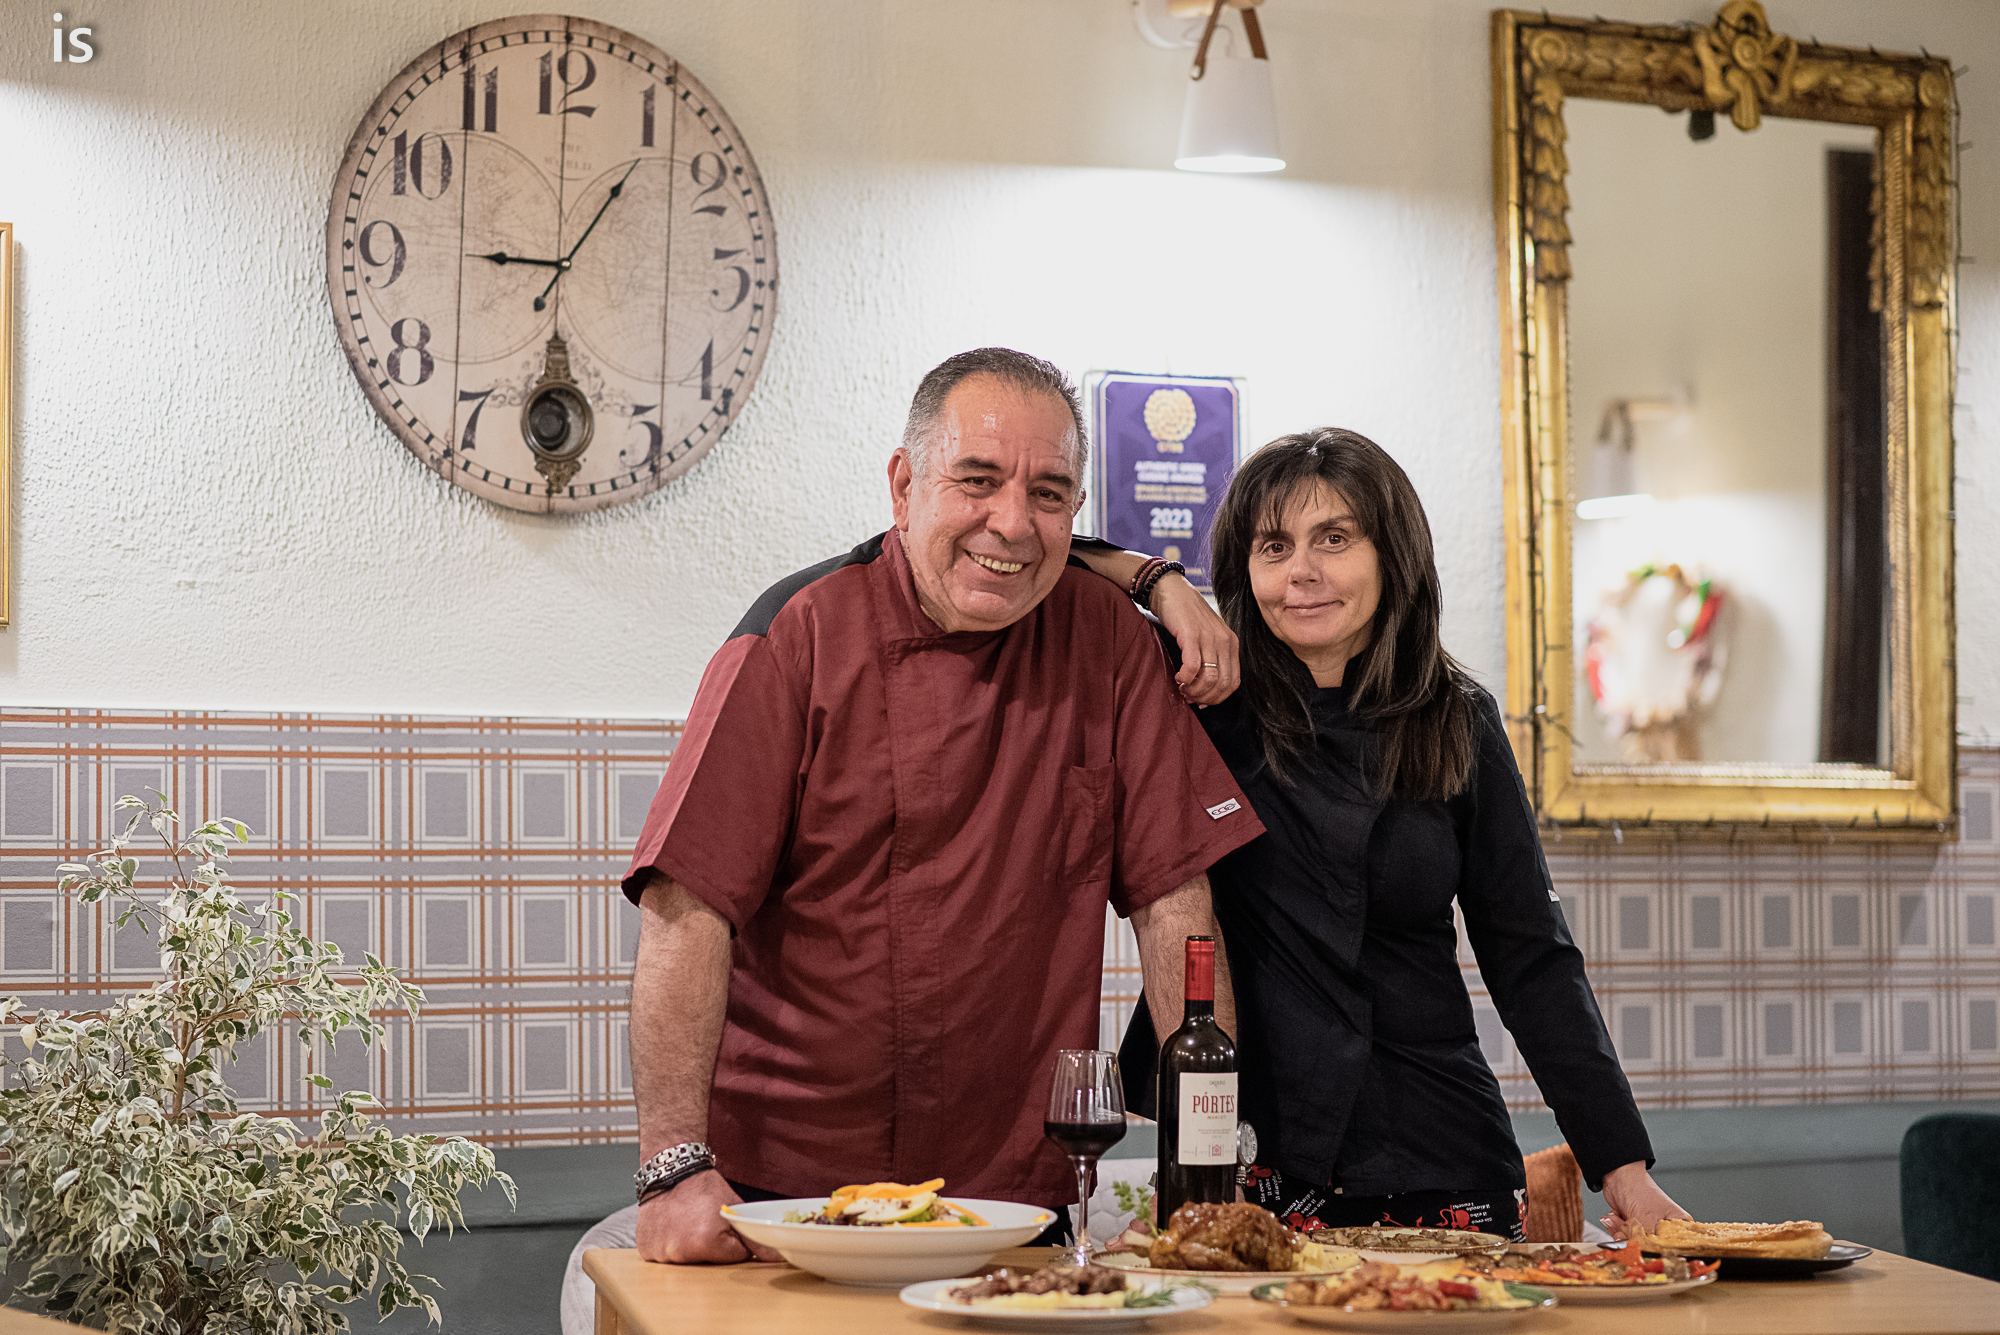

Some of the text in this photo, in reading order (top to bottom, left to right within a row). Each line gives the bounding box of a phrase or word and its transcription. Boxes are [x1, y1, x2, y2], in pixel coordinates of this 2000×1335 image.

[460, 63, 499, 133] 11
[536, 49, 599, 118] 12
[639, 83, 657, 148] 1
[390, 129, 453, 200] 10
[691, 151, 728, 218] 2
[359, 220, 407, 289] 9
[711, 247, 751, 313] 3
[387, 317, 435, 387] 8
[678, 338, 723, 401] 4
[458, 388, 496, 451] 7
[619, 404, 664, 469] 5
[1150, 507, 1193, 529] 2023
[1192, 1091, 1235, 1114] PÓRTES
